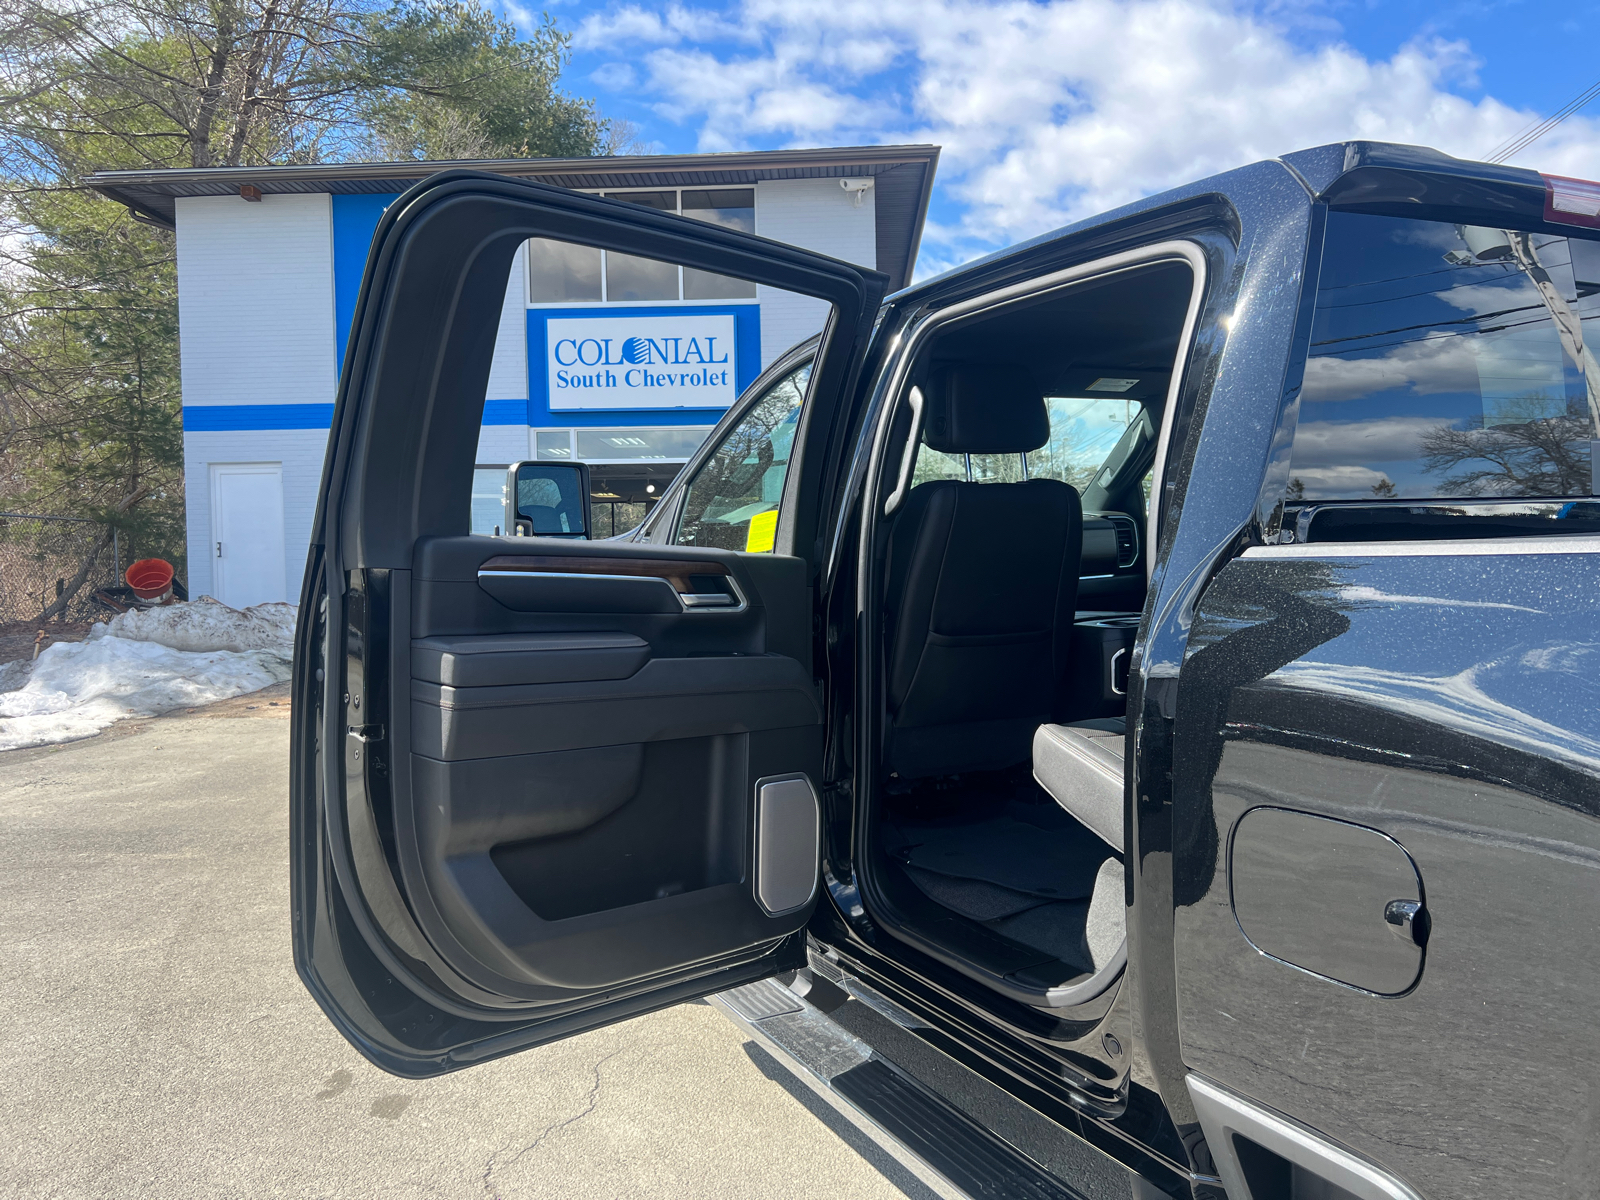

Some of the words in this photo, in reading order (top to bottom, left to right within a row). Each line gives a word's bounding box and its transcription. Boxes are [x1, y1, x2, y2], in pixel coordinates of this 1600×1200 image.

[555, 336, 728, 366] COLONIAL
[556, 370, 616, 389] South
[624, 368, 728, 387] Chevrolet
